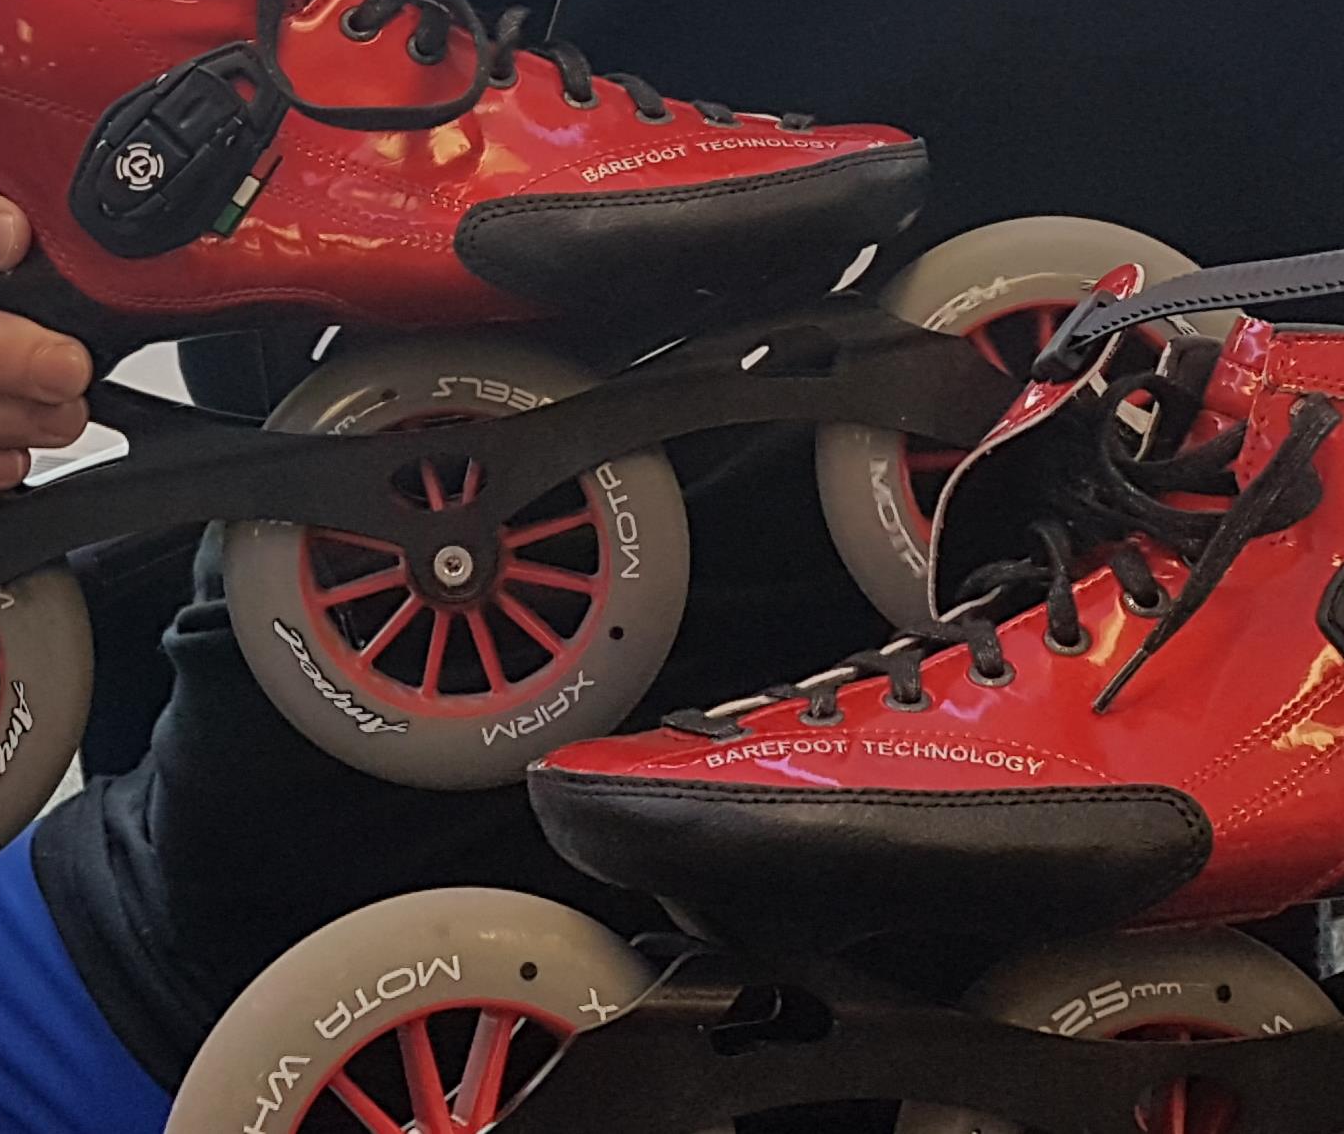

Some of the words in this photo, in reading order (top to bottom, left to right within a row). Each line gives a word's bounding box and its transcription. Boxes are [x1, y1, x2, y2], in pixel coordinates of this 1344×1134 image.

[582, 145, 687, 183] BAREFOOT
[696, 136, 838, 153] TECHNOLOGY
[481, 669, 595, 747] XFIRM
[706, 740, 847, 769] BAREFOOT
[862, 739, 1046, 776] TECHNOLOGY
[314, 955, 462, 1039] MOTA
